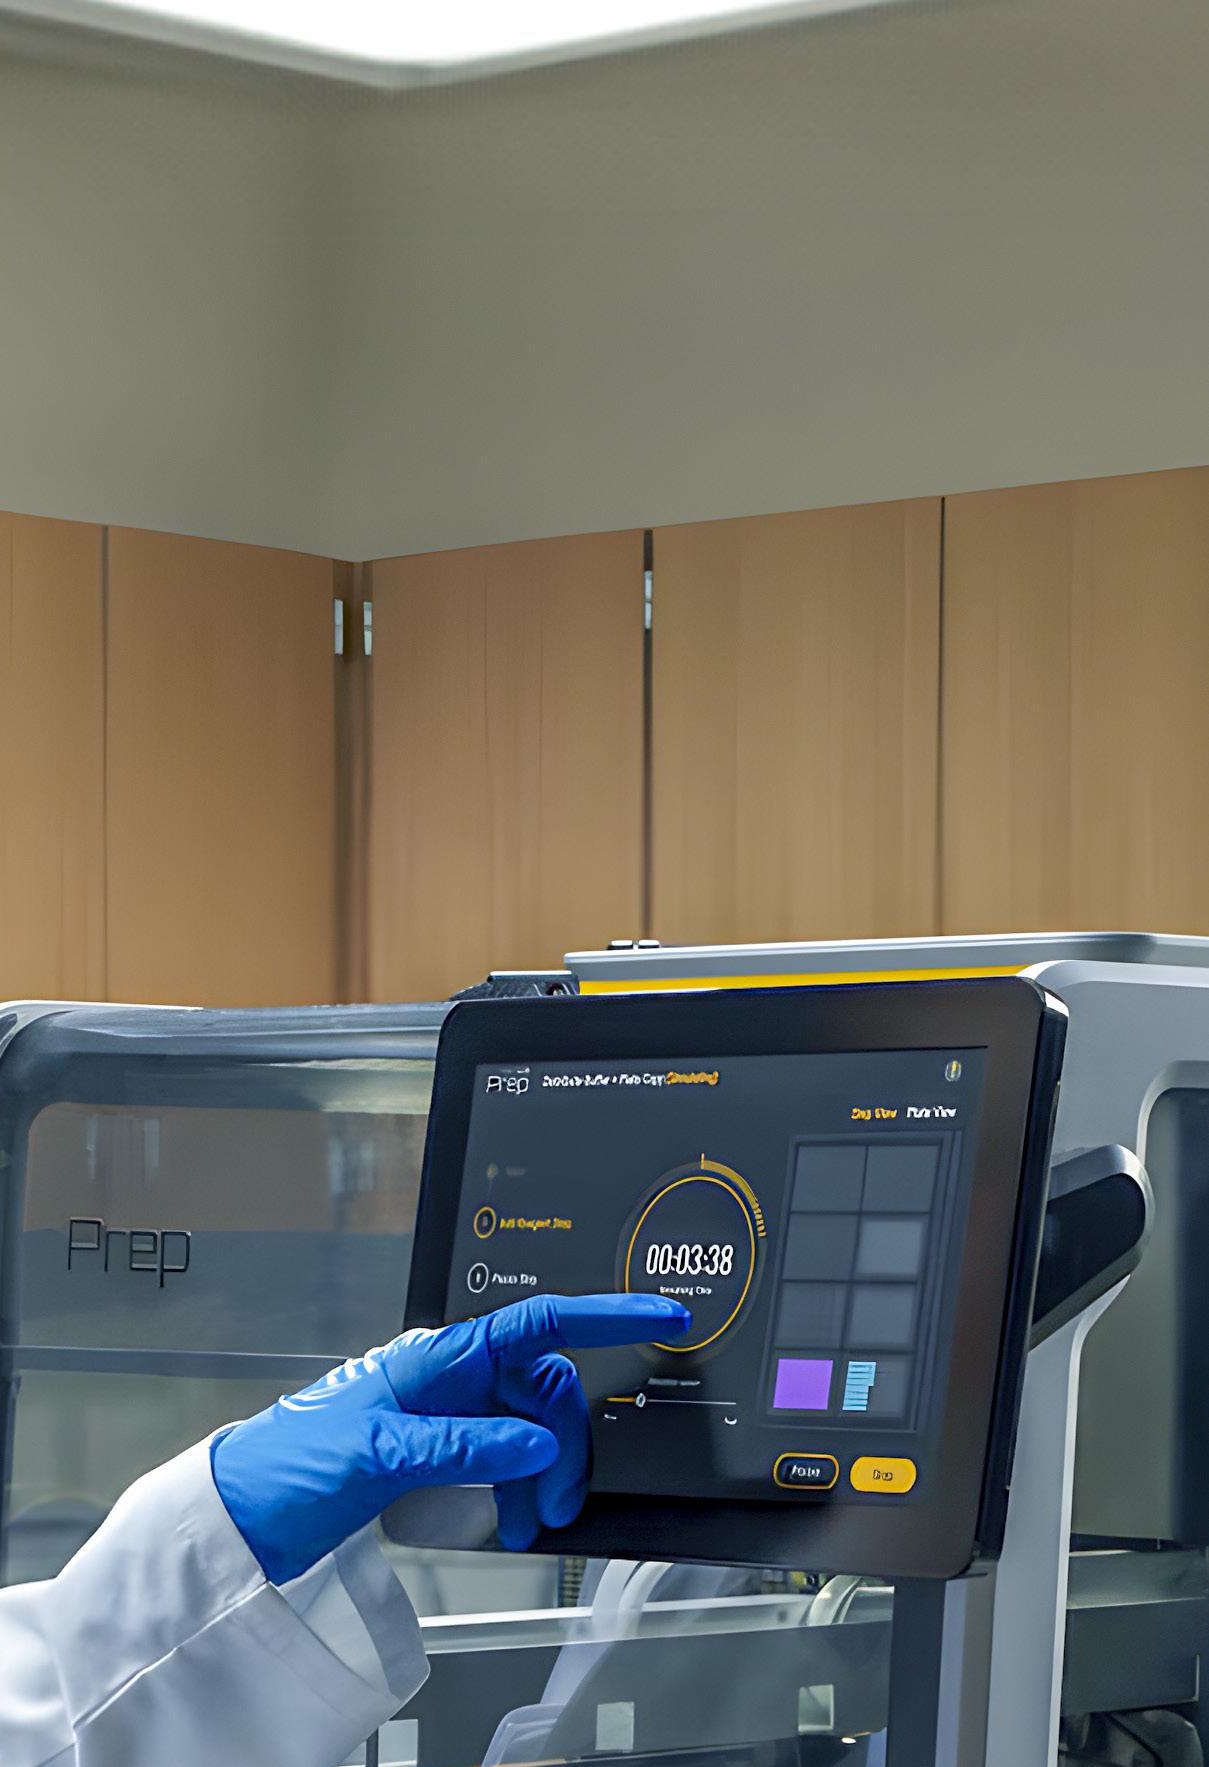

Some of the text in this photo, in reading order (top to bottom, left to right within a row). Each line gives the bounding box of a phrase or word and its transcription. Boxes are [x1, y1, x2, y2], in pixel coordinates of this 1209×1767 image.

[486, 1075, 529, 1095] Prep
[67, 1216, 192, 1288] Prep
[646, 1244, 734, 1276] 00:03:38
